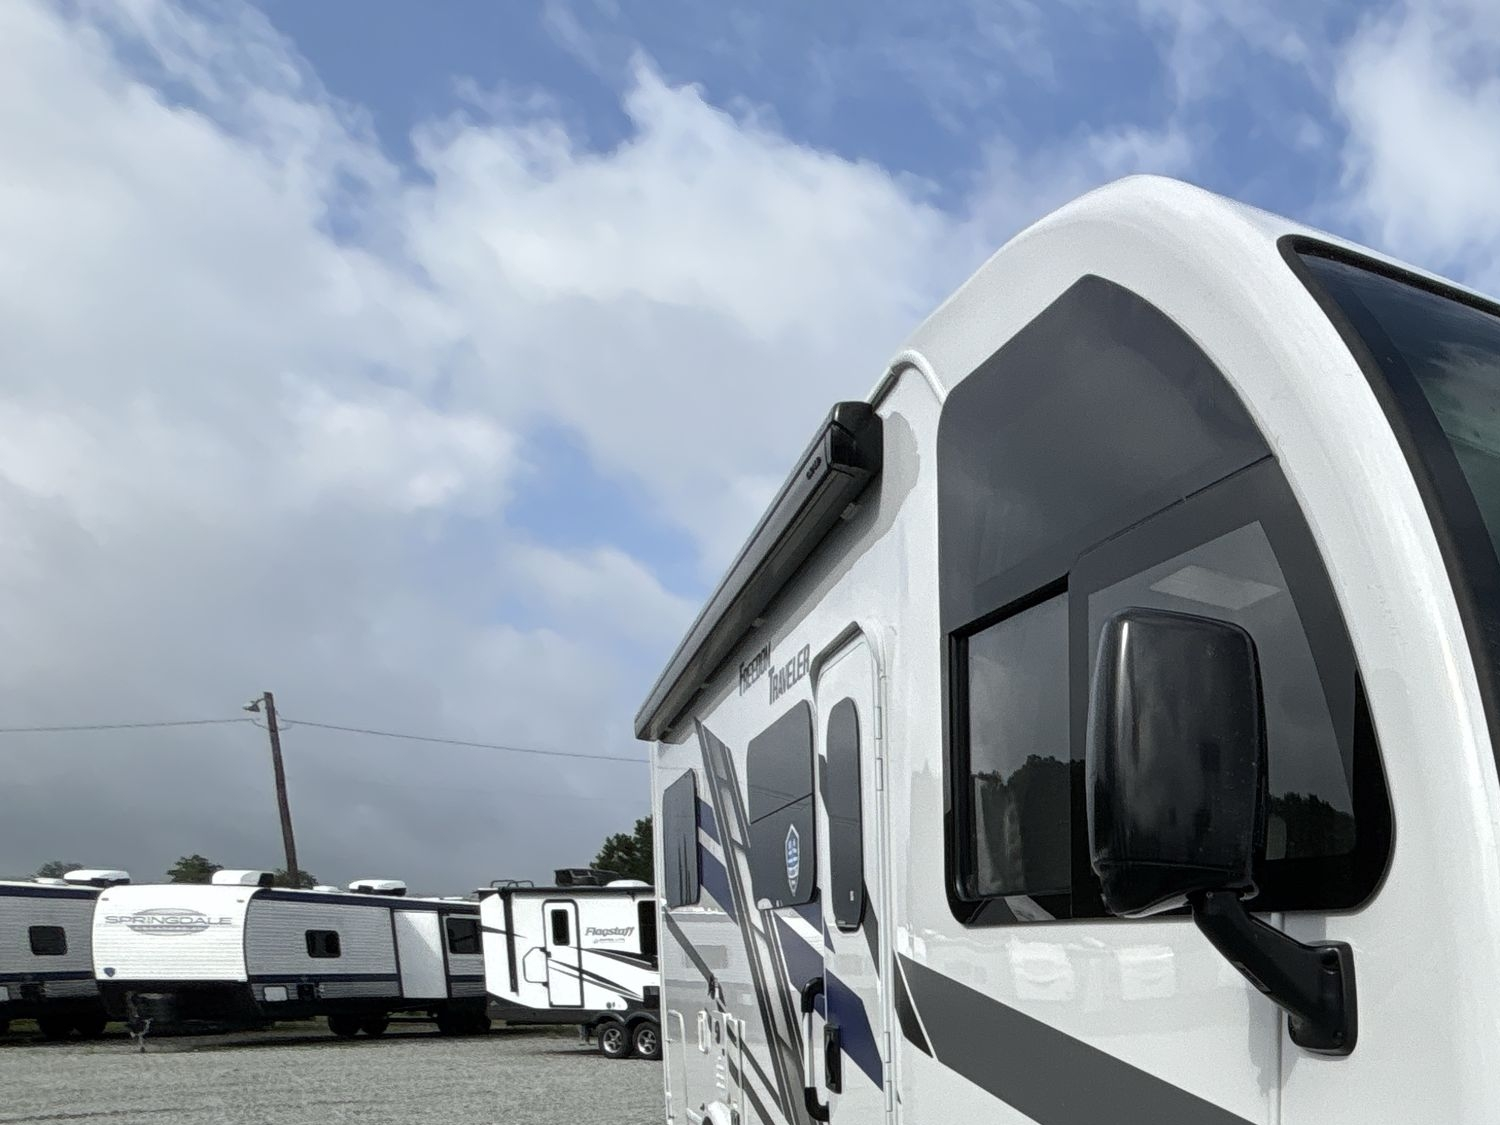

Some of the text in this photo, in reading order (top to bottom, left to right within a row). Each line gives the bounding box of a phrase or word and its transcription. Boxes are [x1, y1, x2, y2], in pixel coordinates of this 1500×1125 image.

[768, 643, 810, 705] TRAVELER
[104, 915, 232, 925] SPRINGDALE
[584, 926, 635, 937] Flagstaff
